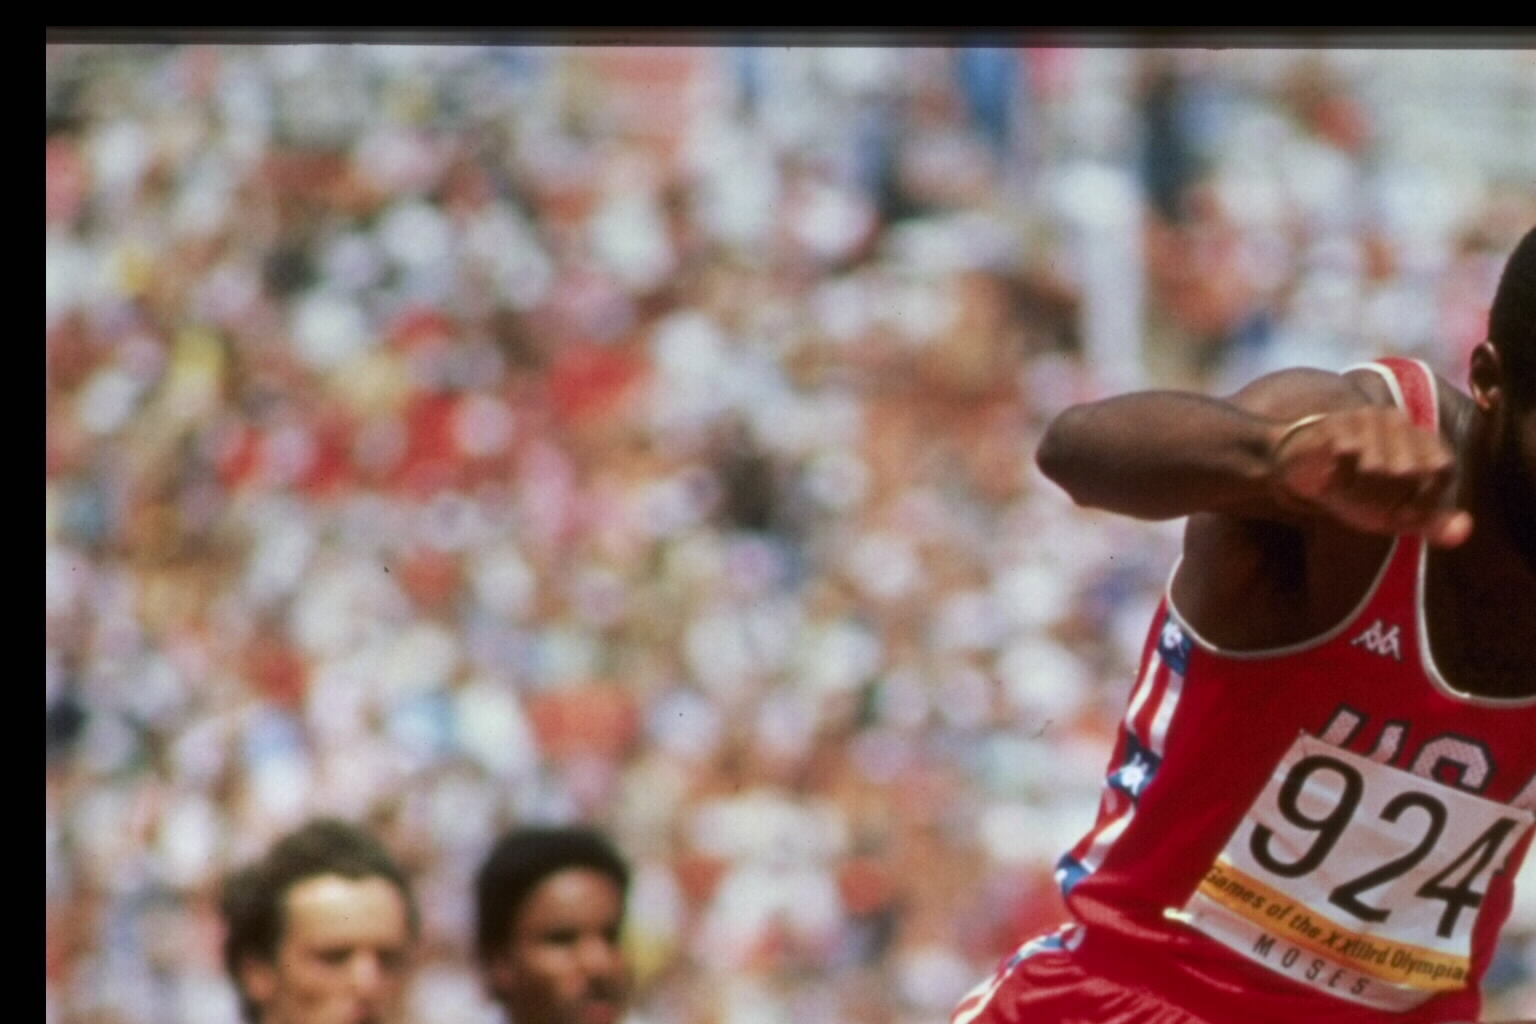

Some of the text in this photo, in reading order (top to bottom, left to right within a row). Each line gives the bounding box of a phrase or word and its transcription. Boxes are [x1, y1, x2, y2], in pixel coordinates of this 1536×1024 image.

[1248, 754, 1520, 939] 924
[1251, 932, 1371, 996] MOSES
[1265, 902, 1296, 921] of
[1288, 914, 1323, 940] the
[1390, 948, 1469, 981] Olympia
